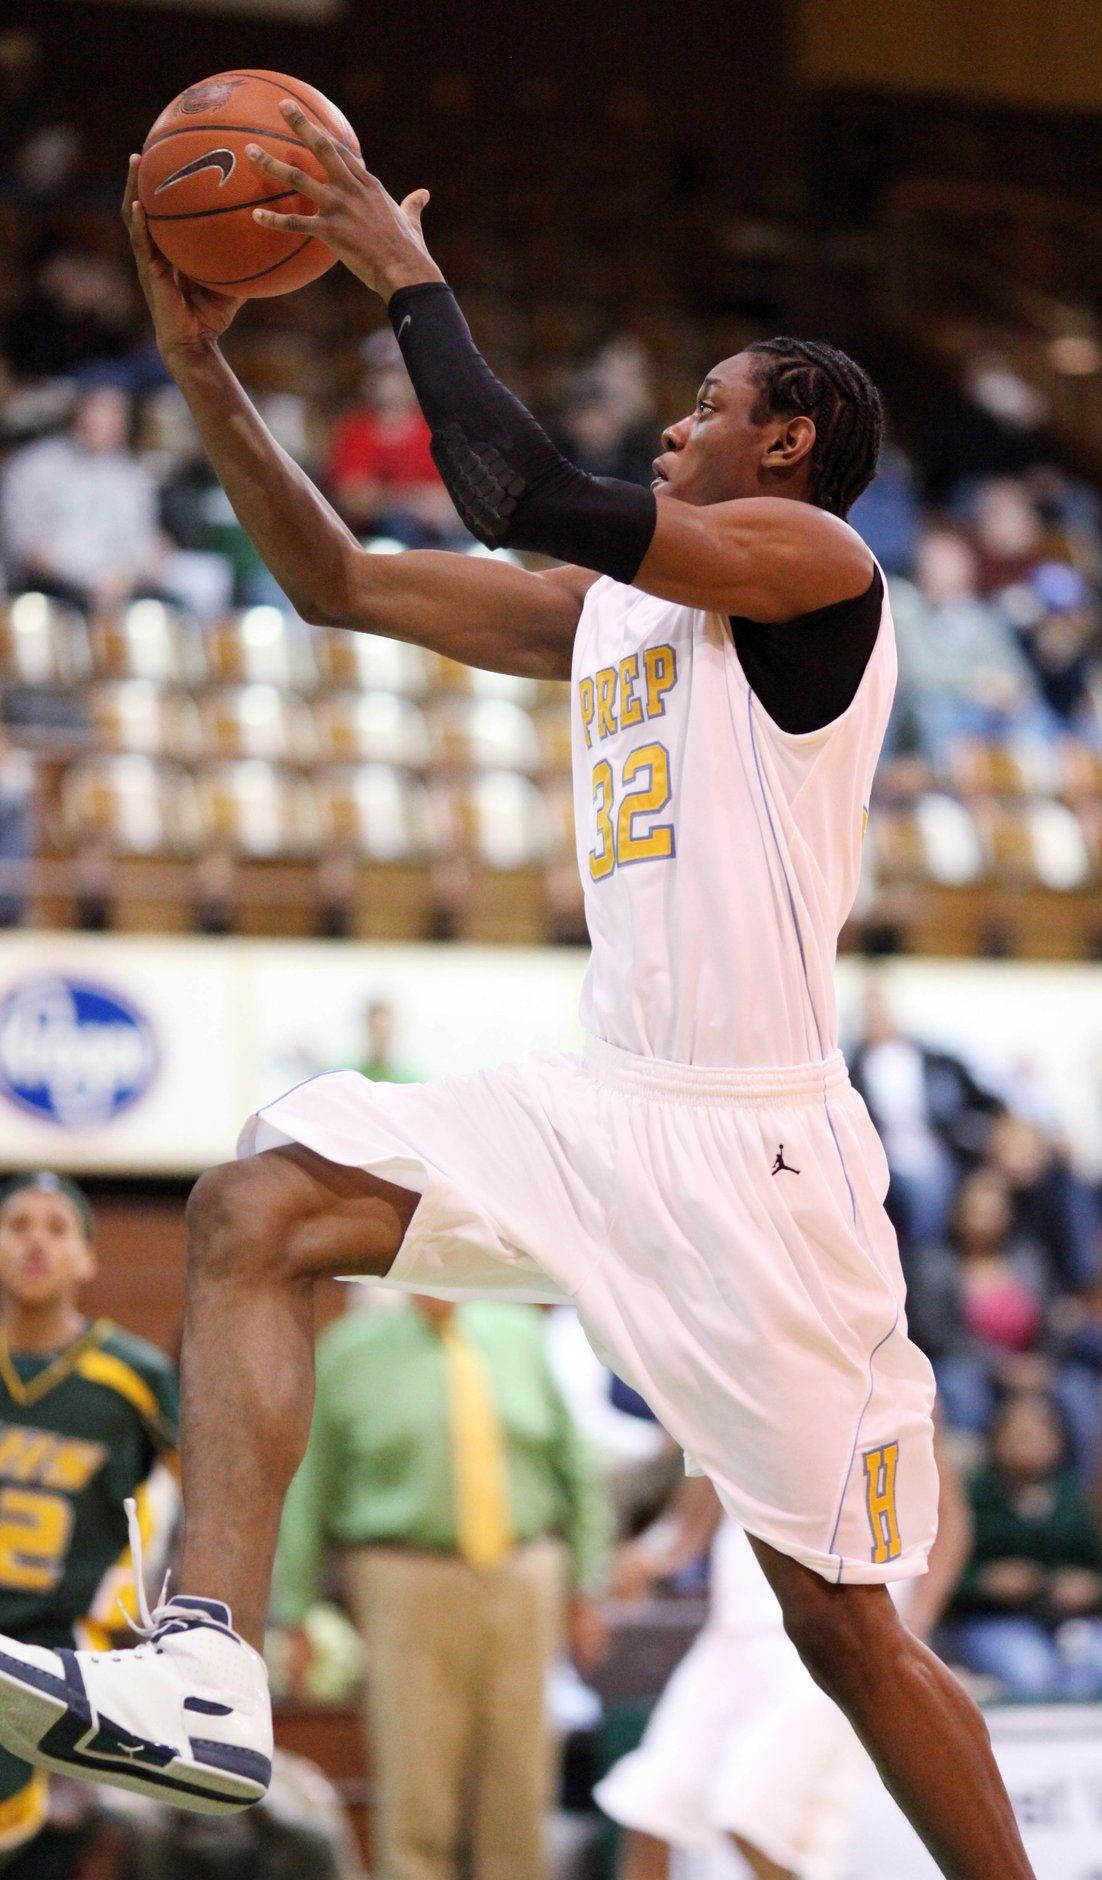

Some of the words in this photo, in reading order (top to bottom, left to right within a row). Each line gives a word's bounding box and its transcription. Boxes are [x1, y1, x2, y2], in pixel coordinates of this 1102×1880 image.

[578, 643, 678, 750] PREP
[588, 740, 676, 884] 32
[862, 1439, 902, 1564] H
